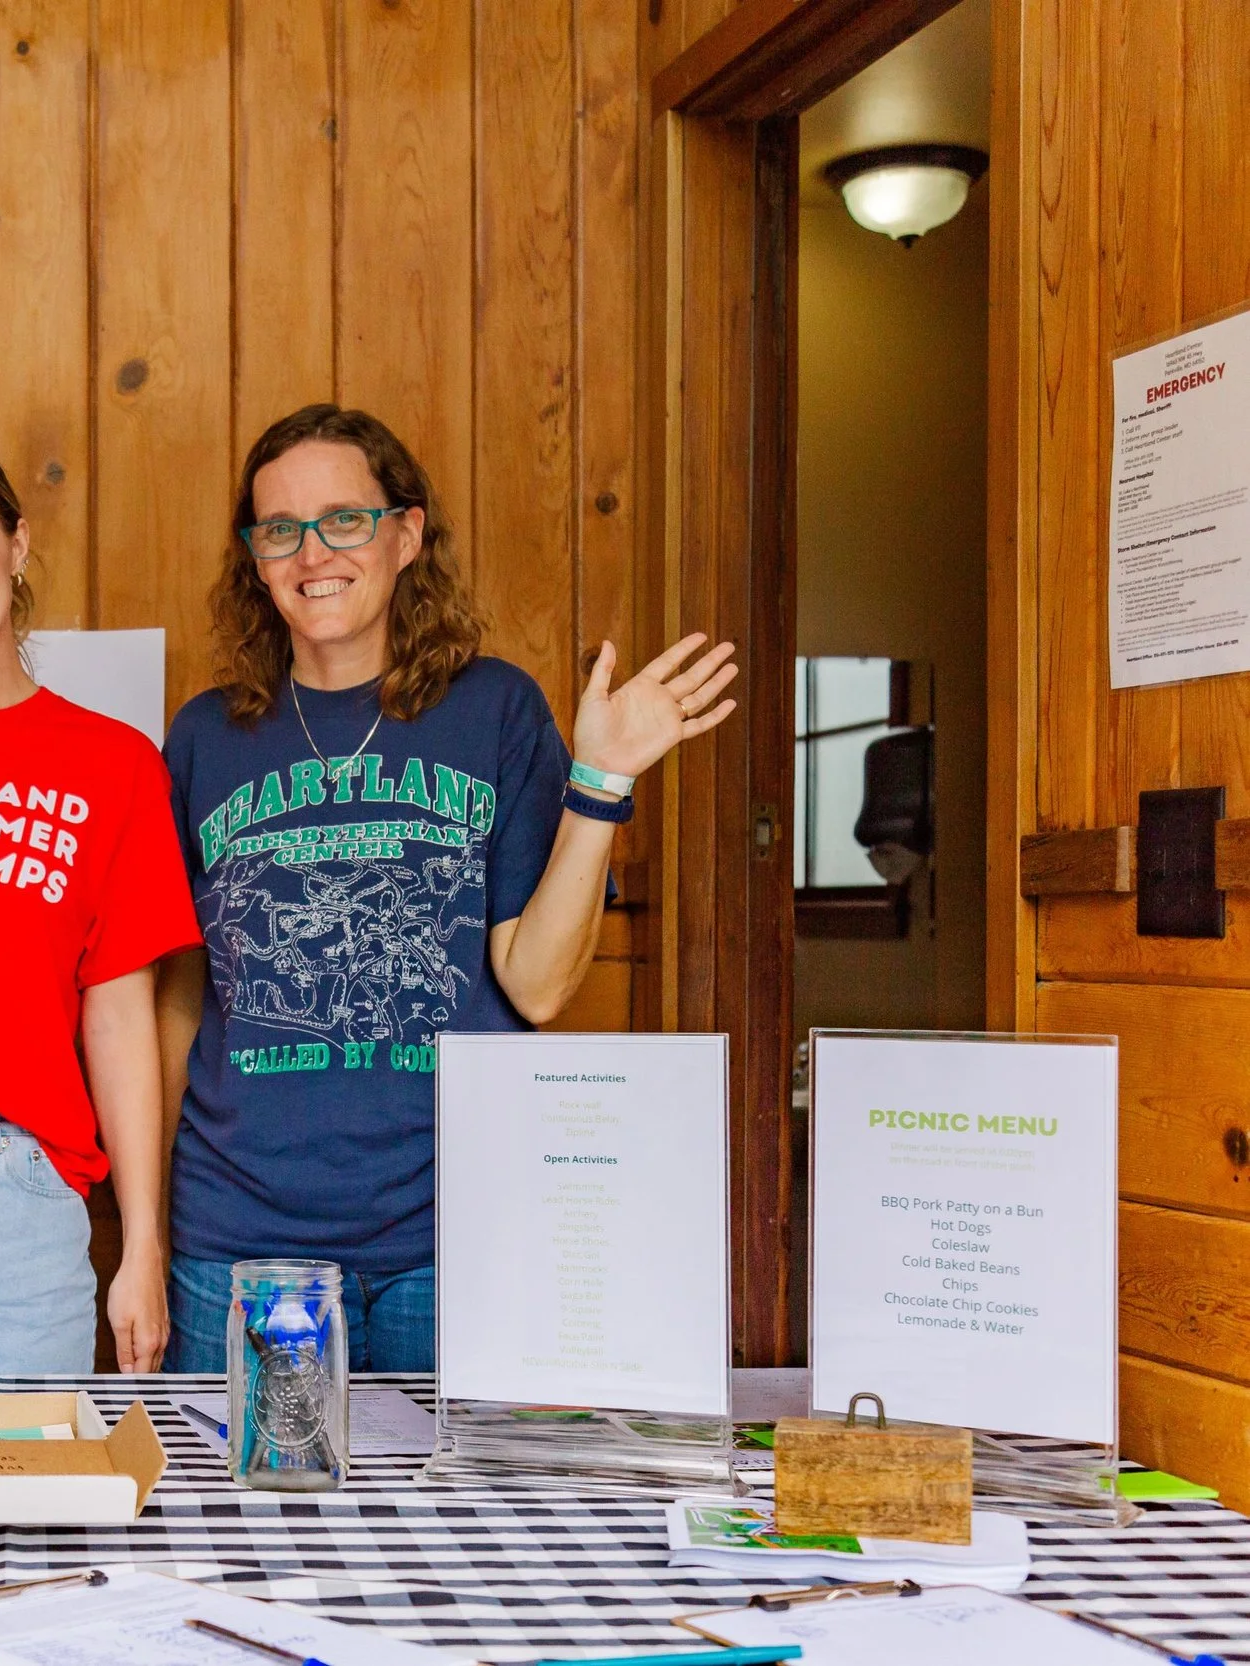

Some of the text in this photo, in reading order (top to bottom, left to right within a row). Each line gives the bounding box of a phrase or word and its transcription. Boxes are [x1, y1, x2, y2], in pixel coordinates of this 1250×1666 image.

[1146, 362, 1226, 404] EMERGENCY
[199, 754, 496, 873] HEARTLAND
[227, 820, 468, 861] PRESBYTERIAN
[272, 840, 405, 867] CENTER
[344, 1041, 376, 1069] BY
[534, 1073, 627, 1083] Featured Activities
[869, 1109, 1058, 1137] PICNIC MENU
[543, 1154, 619, 1165] Open Activities
[881, 1195, 1044, 1218] BBQ Pork Patty on a Bun
[930, 1218, 992, 1236] Hot Dogs
[931, 1237, 990, 1254] Coleslaw
[902, 1255, 1021, 1276] Cold Baked Beans
[942, 1277, 979, 1294] Chips
[884, 1291, 1039, 1317] Chocolate Chip Cookies
[897, 1312, 1025, 1336] Lemonade & Water
